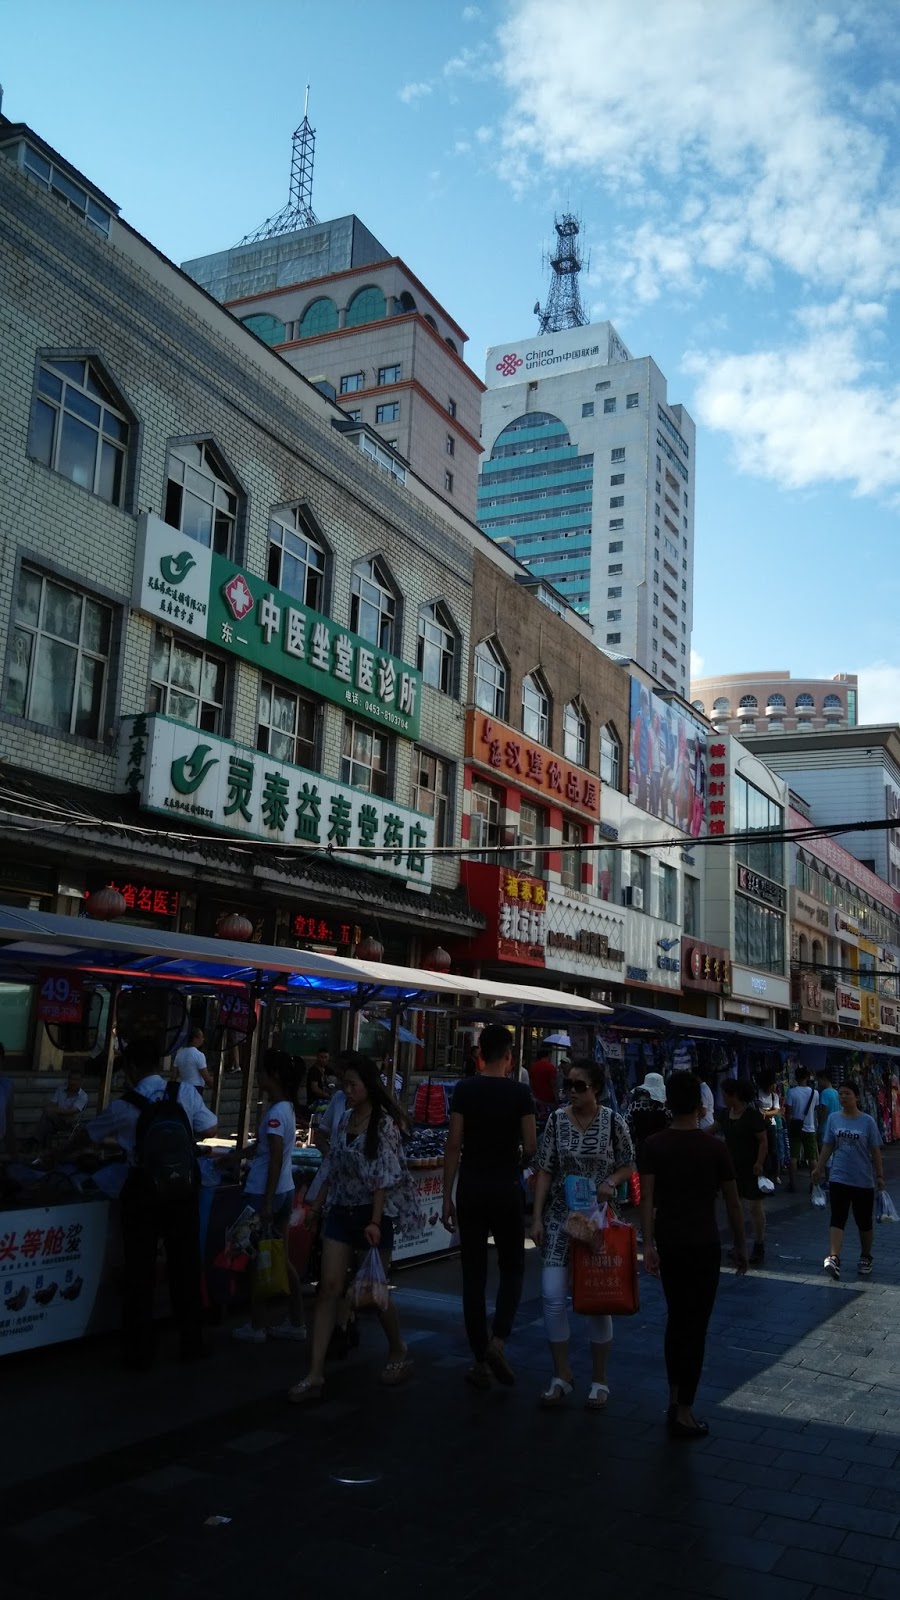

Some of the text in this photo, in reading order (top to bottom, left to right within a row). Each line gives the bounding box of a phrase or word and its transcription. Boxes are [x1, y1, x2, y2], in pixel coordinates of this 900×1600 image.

[525, 355, 562, 370] unicom
[526, 348, 554, 361] China
[563, 345, 599, 362] 中国联通
[220, 621, 248, 645] 东一
[258, 593, 417, 717] 中医坐堂医诊所
[125, 712, 149, 794] 益寿堂
[223, 755, 428, 874] 灵泰益寿堂药店
